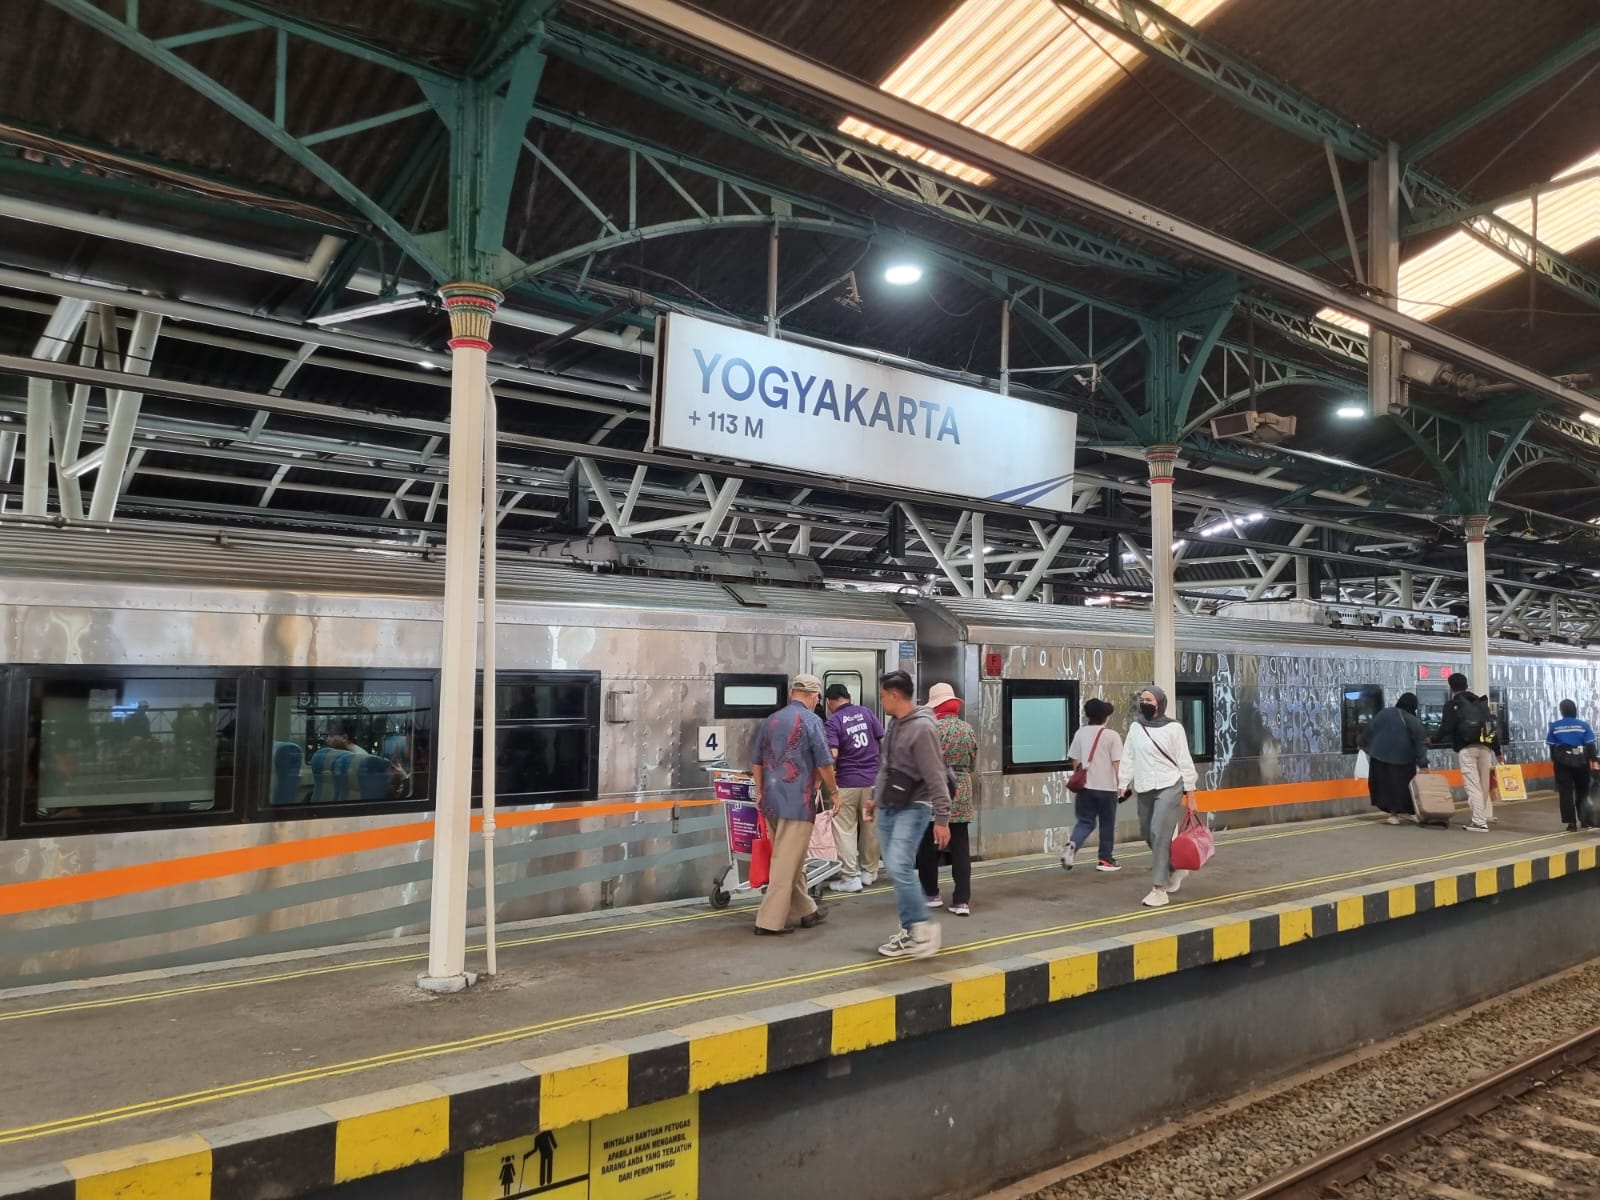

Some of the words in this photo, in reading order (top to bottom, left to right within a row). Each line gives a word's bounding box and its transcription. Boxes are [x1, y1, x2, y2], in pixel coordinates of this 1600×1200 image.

[692, 347, 961, 446] YOGYAKARTA
[707, 411, 738, 435] 113
[744, 417, 764, 440] M
[705, 733, 718, 751] 4
[852, 732, 869, 749] 30
[603, 1134, 634, 1150] MINTALAH
[635, 1125, 663, 1141] BANTUAN
[664, 1118, 691, 1133] PETUGAS
[607, 1148, 633, 1162] APABILA
[633, 1143, 651, 1157] AKAN
[652, 1133, 686, 1148] MENGAMBIL
[601, 1160, 627, 1175] BARANG
[627, 1156, 643, 1168] ANDA
[645, 1150, 661, 1164] YANG
[662, 1142, 692, 1157] TERJATUH
[618, 1172, 633, 1183] DARI
[633, 1165, 654, 1178] PERON
[655, 1159, 676, 1172] TINGGI
